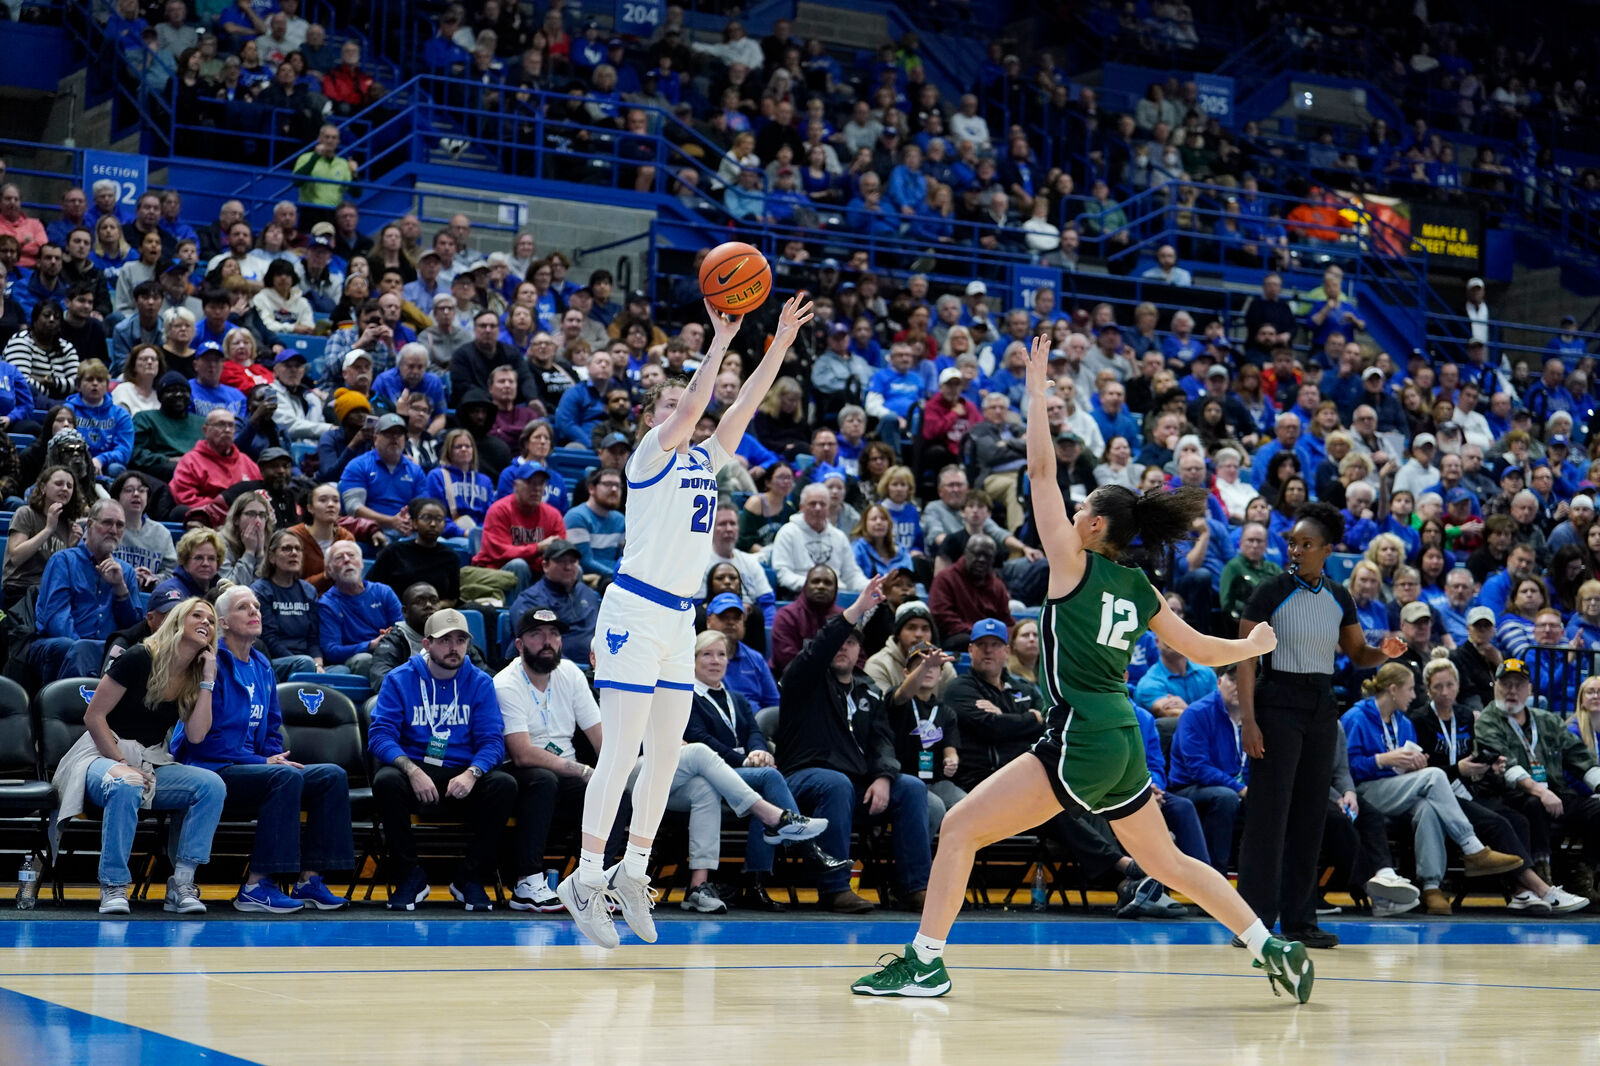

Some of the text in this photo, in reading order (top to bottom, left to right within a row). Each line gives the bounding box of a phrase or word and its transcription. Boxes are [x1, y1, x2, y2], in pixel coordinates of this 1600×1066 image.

[622, 3, 658, 26] 204
[92, 164, 139, 179] SECTION
[1422, 224, 1457, 240] MAPLE
[1447, 242, 1478, 258] HOME
[725, 280, 763, 305] ELITE
[691, 494, 716, 533] 21
[1096, 591, 1139, 651] 12
[411, 704, 471, 727] BUFFALO
